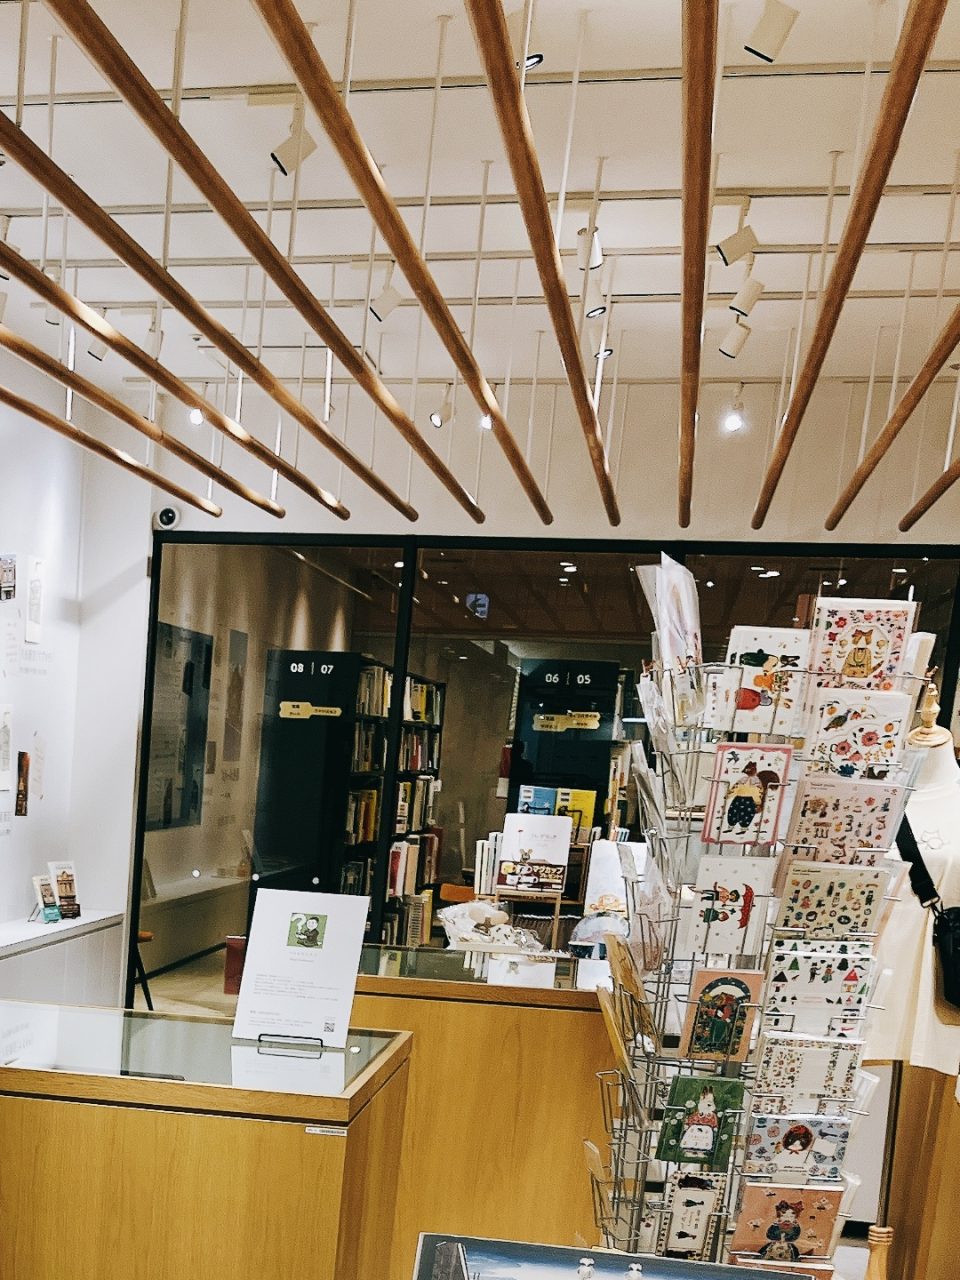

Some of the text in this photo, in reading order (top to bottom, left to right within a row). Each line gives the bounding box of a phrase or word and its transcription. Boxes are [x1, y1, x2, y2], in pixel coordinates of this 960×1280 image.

[290, 663, 334, 674] 08 07
[545, 673, 591, 684] 06 05
